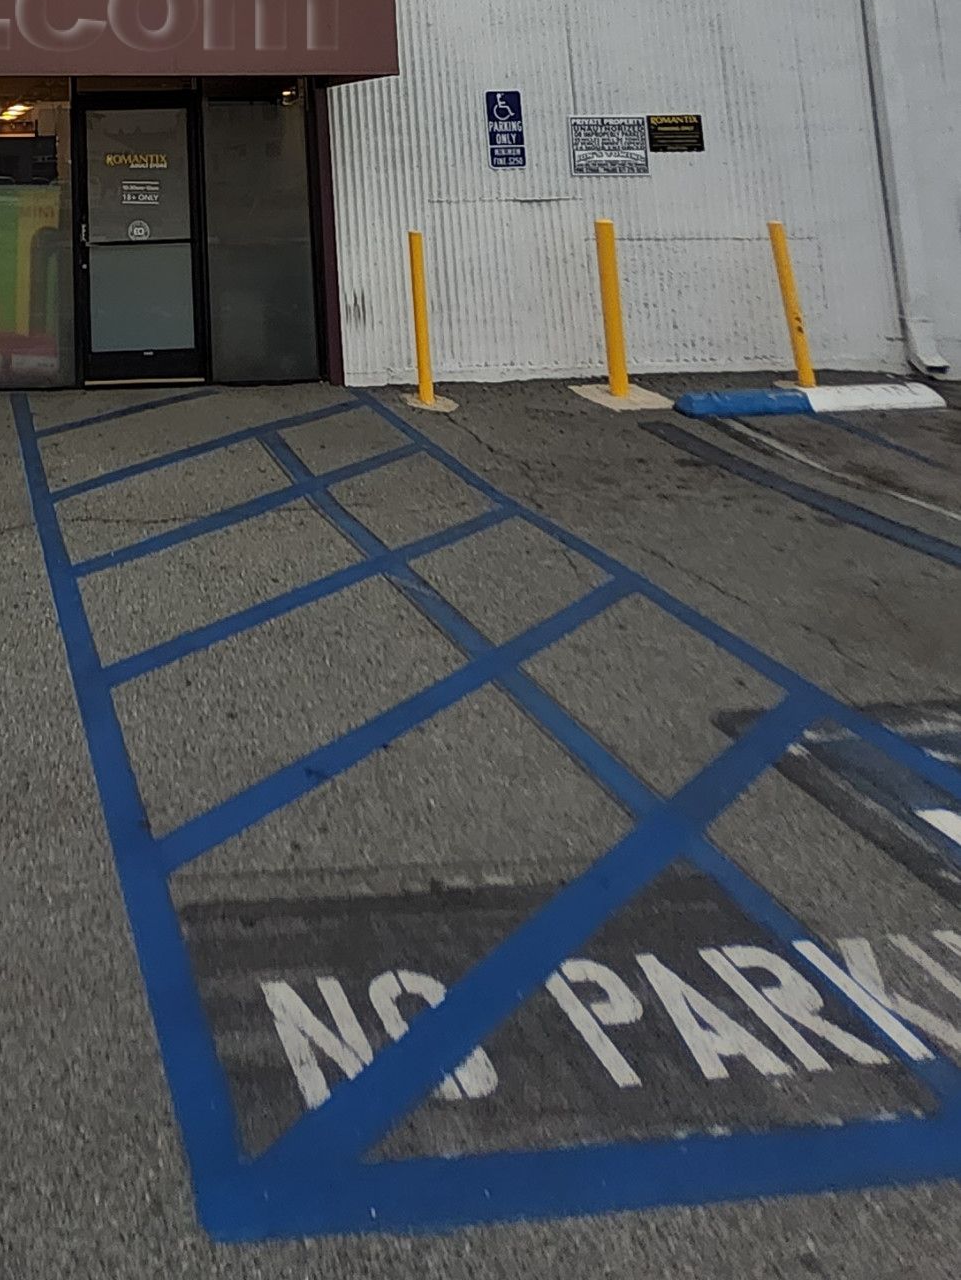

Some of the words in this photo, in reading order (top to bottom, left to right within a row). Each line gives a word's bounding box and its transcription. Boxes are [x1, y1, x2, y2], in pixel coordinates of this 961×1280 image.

[488, 121, 522, 132] PARKING
[650, 116, 698, 126] ROMANTIX
[496, 133, 517, 145] ONLY
[105, 154, 167, 166] ROMANTIX
[122, 193, 137, 201] 18+
[138, 193, 159, 201] ONLY
[545, 929, 961, 1089] PARKI
